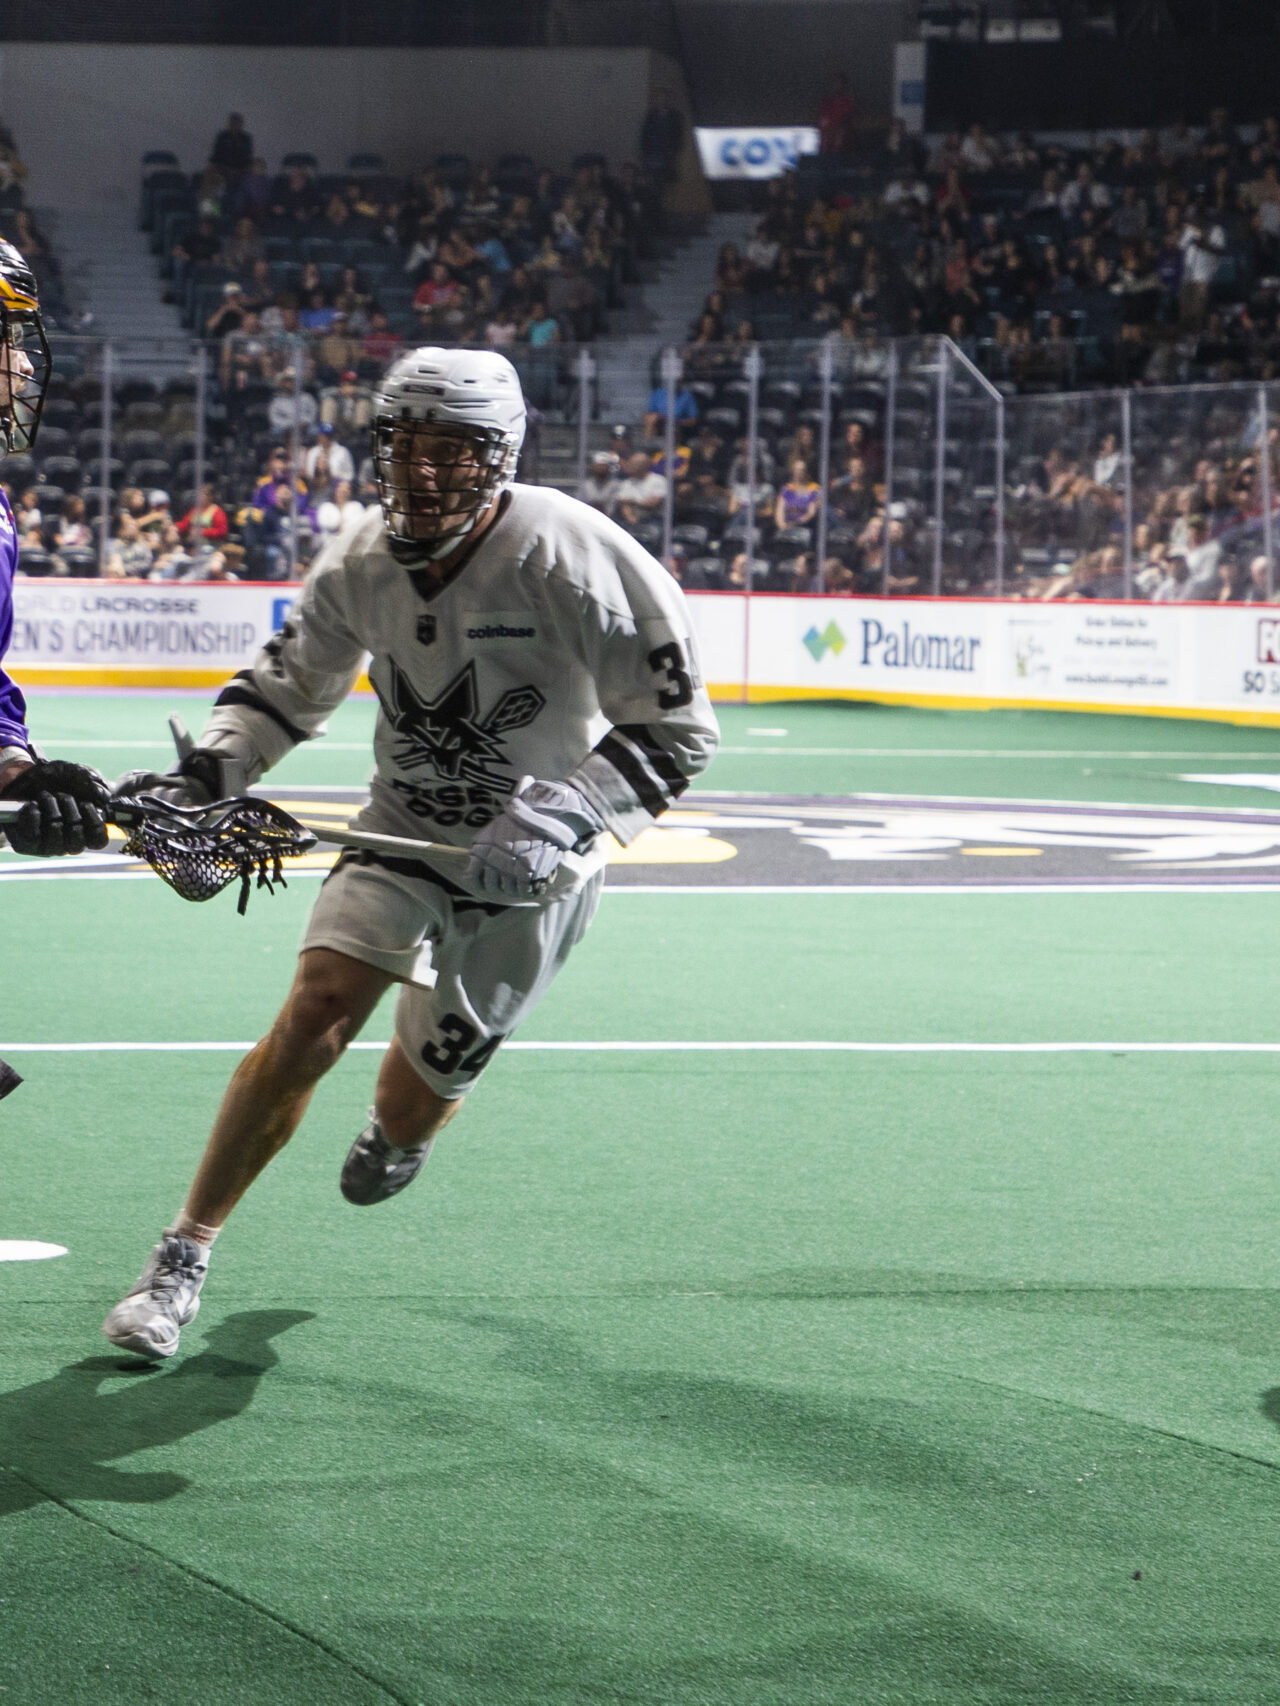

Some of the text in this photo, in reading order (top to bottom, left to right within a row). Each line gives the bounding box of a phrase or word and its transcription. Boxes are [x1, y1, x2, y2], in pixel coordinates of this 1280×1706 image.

[14, 594, 199, 613] ORLD LACROSSE
[13, 618, 255, 653] EN'S CHAMPIONSHIP
[467, 624, 536, 639] coinbase
[861, 618, 980, 671] Palomar
[1244, 671, 1265, 693] SO
[406, 796, 496, 828] DOG
[421, 1013, 505, 1081] 34
